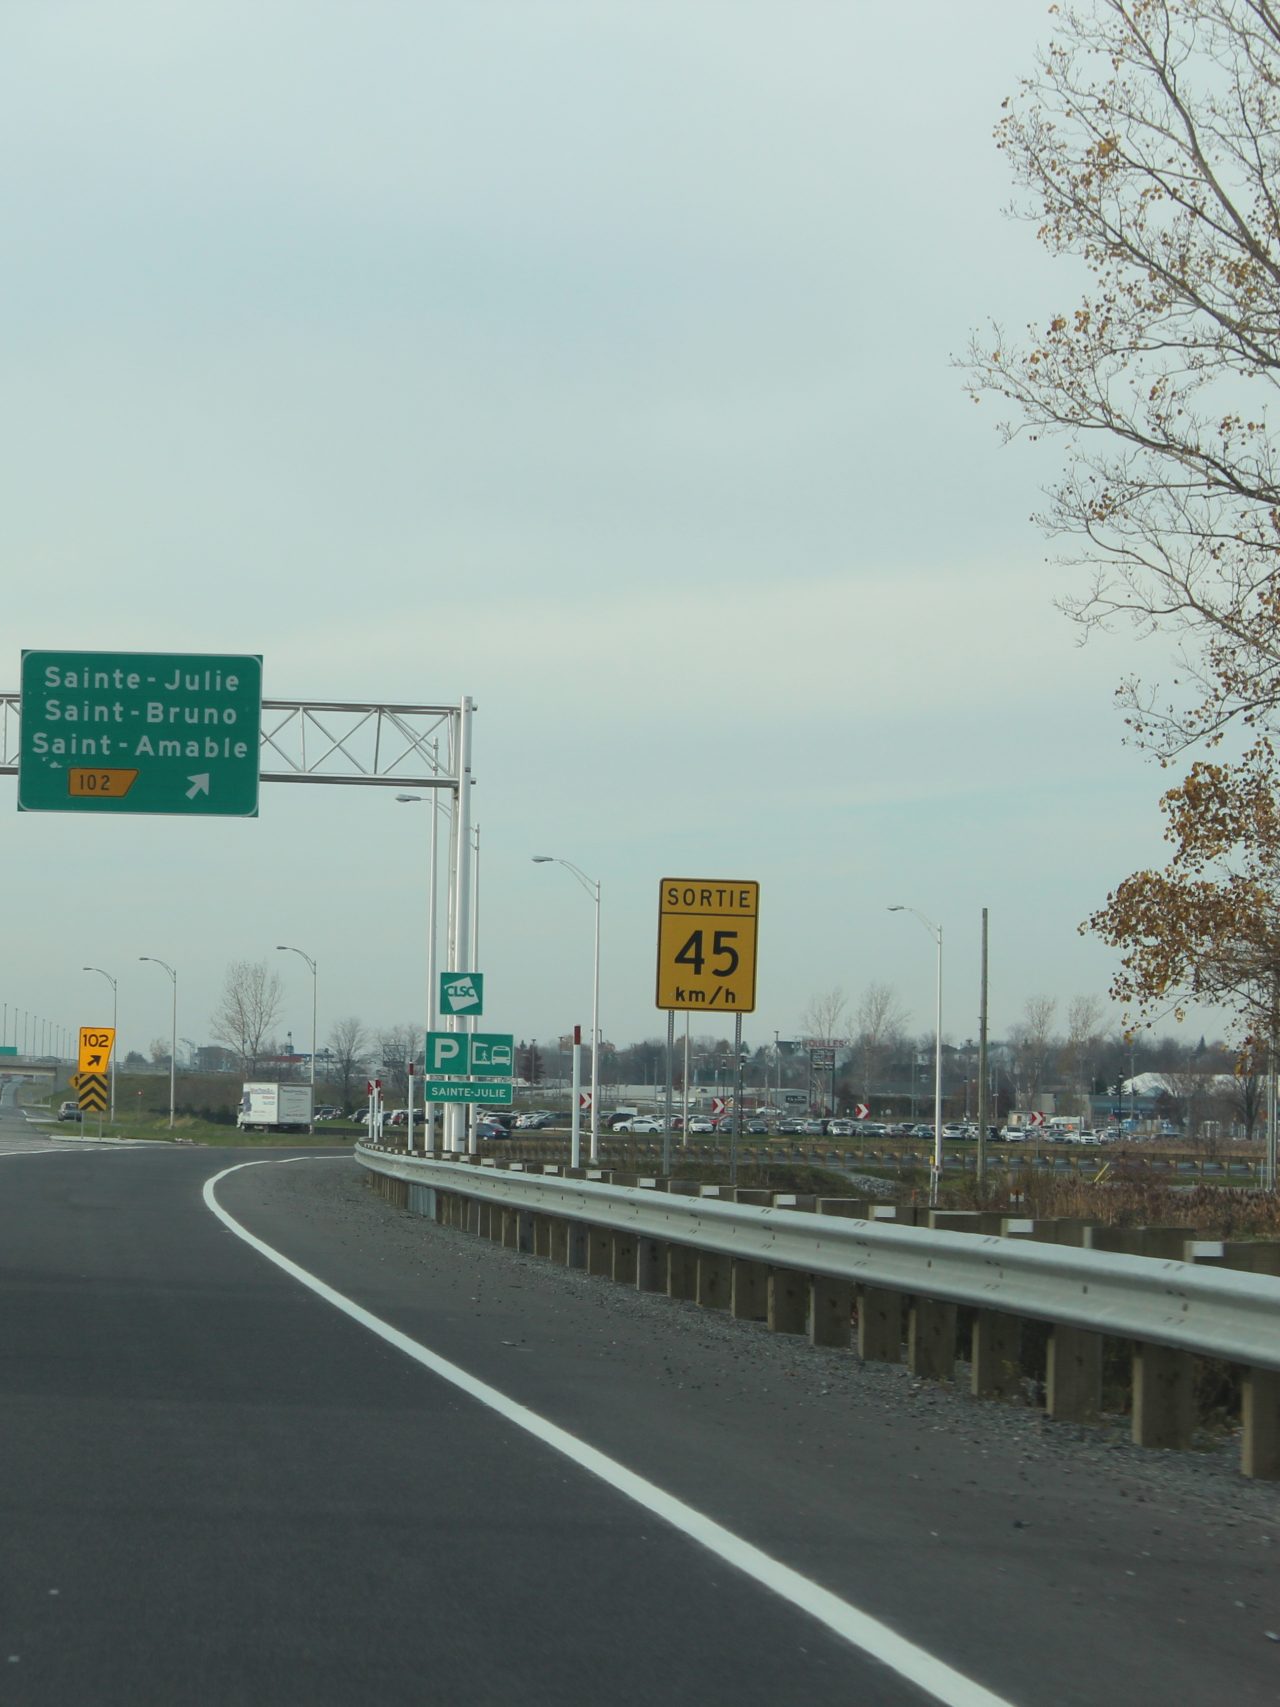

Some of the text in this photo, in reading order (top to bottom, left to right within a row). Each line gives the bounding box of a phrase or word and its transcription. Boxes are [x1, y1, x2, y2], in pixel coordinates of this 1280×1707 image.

[44, 666, 240, 691] Sainte-Julie
[44, 699, 237, 725] Saint-Bruno
[32, 732, 248, 758] Saint-Amable
[79, 774, 110, 791] 102
[667, 888, 751, 908] SORTIE
[674, 930, 739, 977] 45
[446, 985, 475, 997] CLSC
[675, 986, 736, 1005] km/h
[83, 1033, 109, 1048] 102
[434, 1038, 460, 1069] P
[431, 1087, 507, 1098] SAINTE-JULIE
